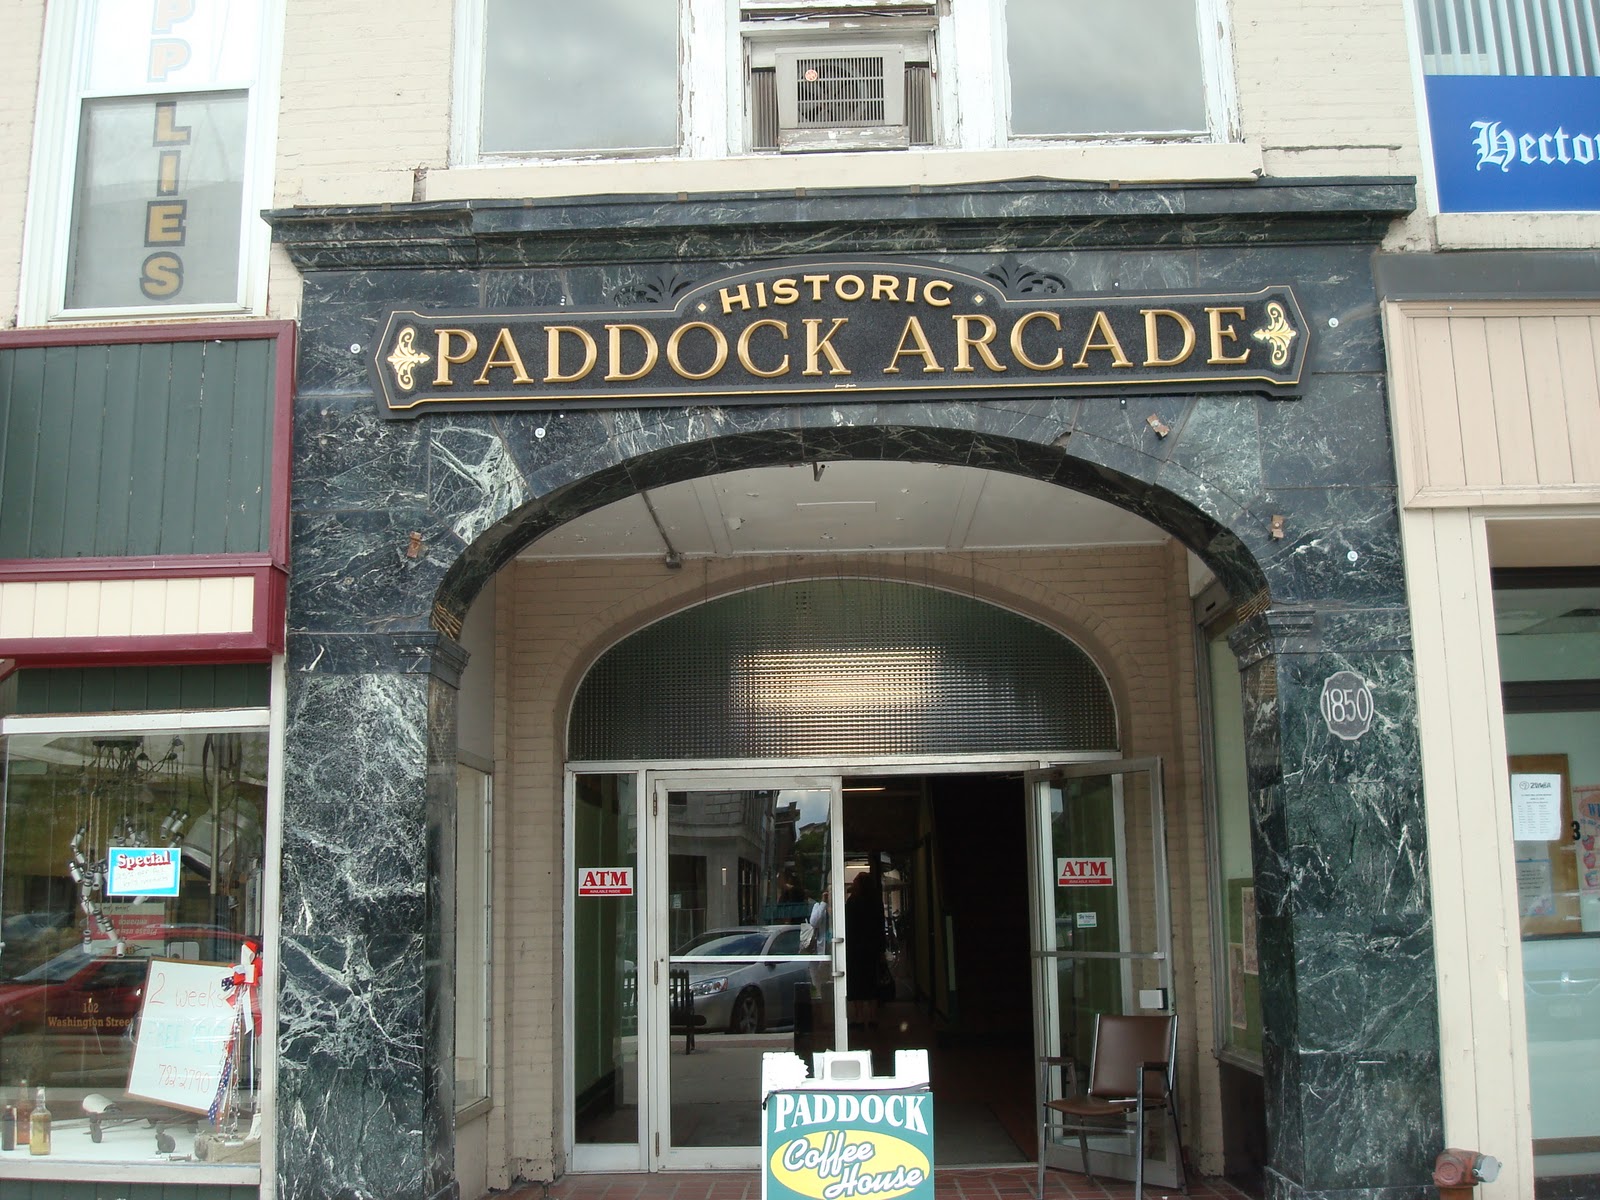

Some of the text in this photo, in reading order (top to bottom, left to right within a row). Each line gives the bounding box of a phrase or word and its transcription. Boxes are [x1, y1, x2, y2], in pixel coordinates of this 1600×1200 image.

[718, 274, 954, 314] HISTORIC
[432, 306, 1251, 386] PADDOCK ARCADE
[1324, 688, 1369, 722] 1850
[117, 849, 171, 871] Special
[1062, 861, 1107, 877] ATM
[582, 871, 628, 886] ATM
[82, 1002, 99, 1014] 102
[149, 972, 224, 1009] 2 weeks
[47, 1016, 104, 1029] Washington
[774, 1094, 928, 1135] PADDOCK
[783, 1131, 875, 1178] Coffee
[823, 1162, 925, 1198] House
